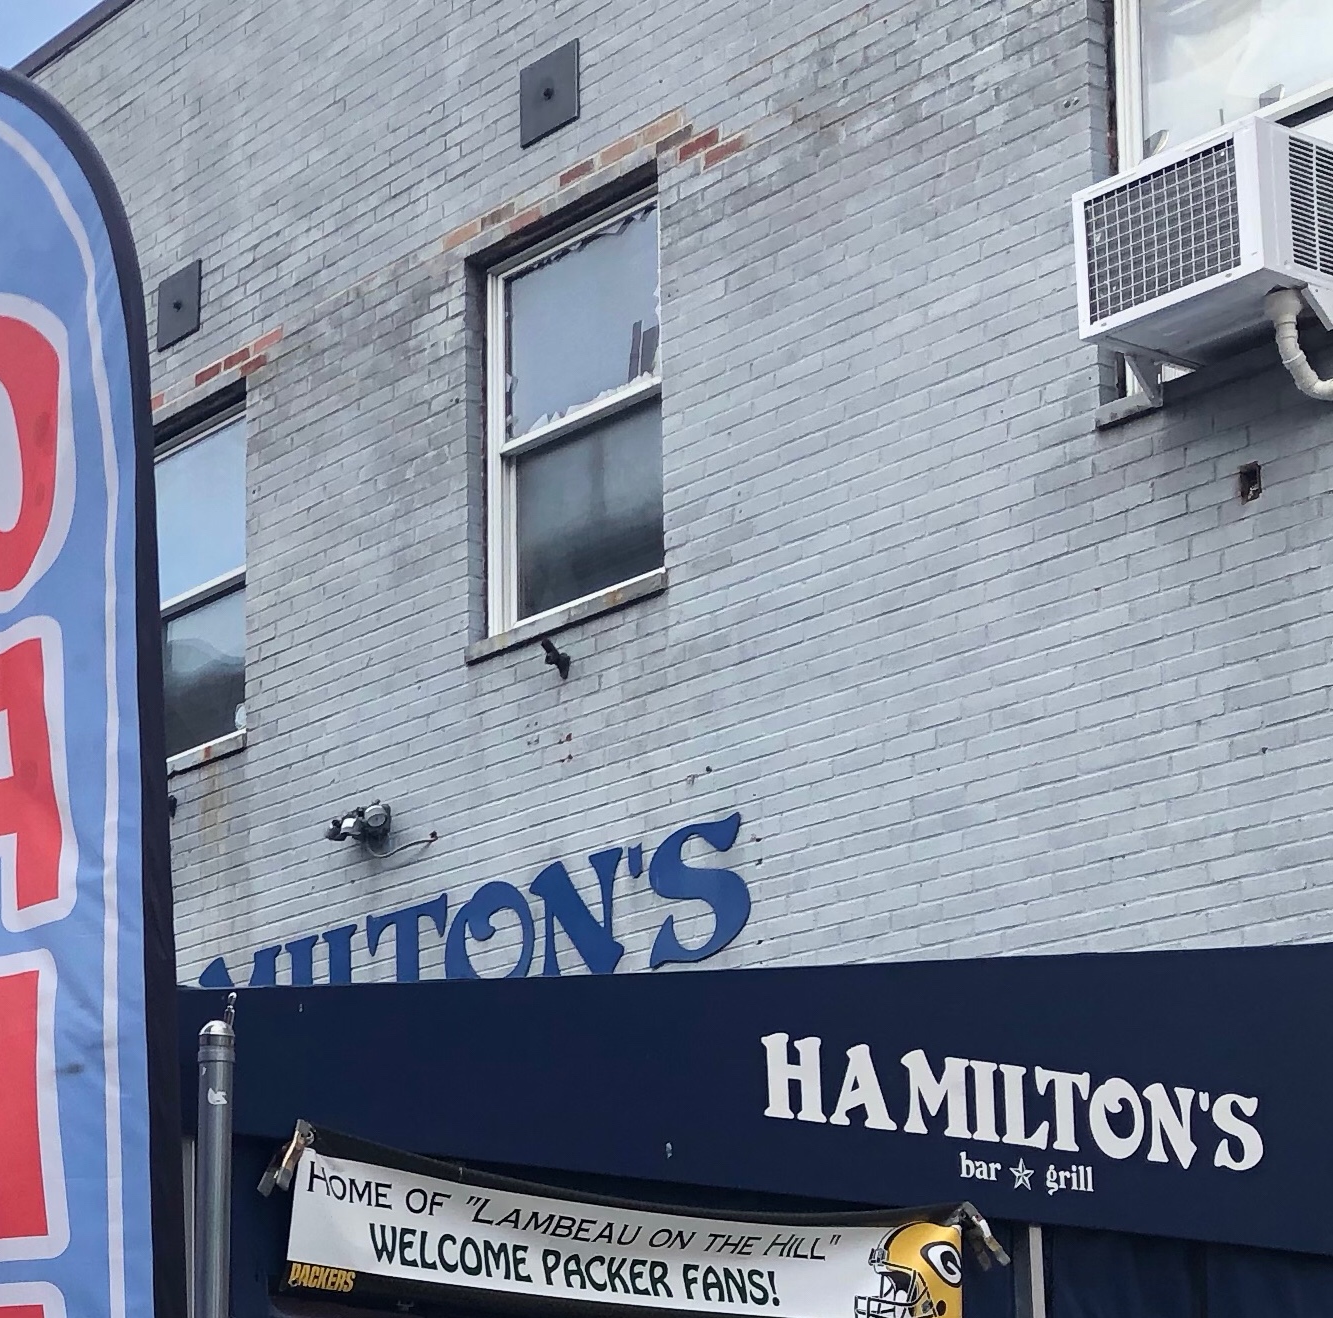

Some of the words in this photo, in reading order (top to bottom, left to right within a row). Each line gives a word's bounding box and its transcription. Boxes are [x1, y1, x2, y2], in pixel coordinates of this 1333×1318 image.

[761, 1031, 1265, 1172] HAMILTON'S
[959, 1151, 1002, 1182] bar
[1045, 1161, 1094, 1196] grill
[306, 1160, 393, 1210] HOME
[405, 1187, 452, 1217] OF
[465, 1195, 642, 1246] "LAMBEAU
[648, 1228, 697, 1251] ON
[703, 1231, 763, 1256] THE
[763, 1233, 842, 1262] HILL"
[288, 1262, 356, 1293] PACKERS
[369, 1222, 533, 1284] WELCOME
[542, 1248, 669, 1299] PACKER
[681, 1262, 781, 1307] FANS!
[920, 1241, 962, 1288] G
